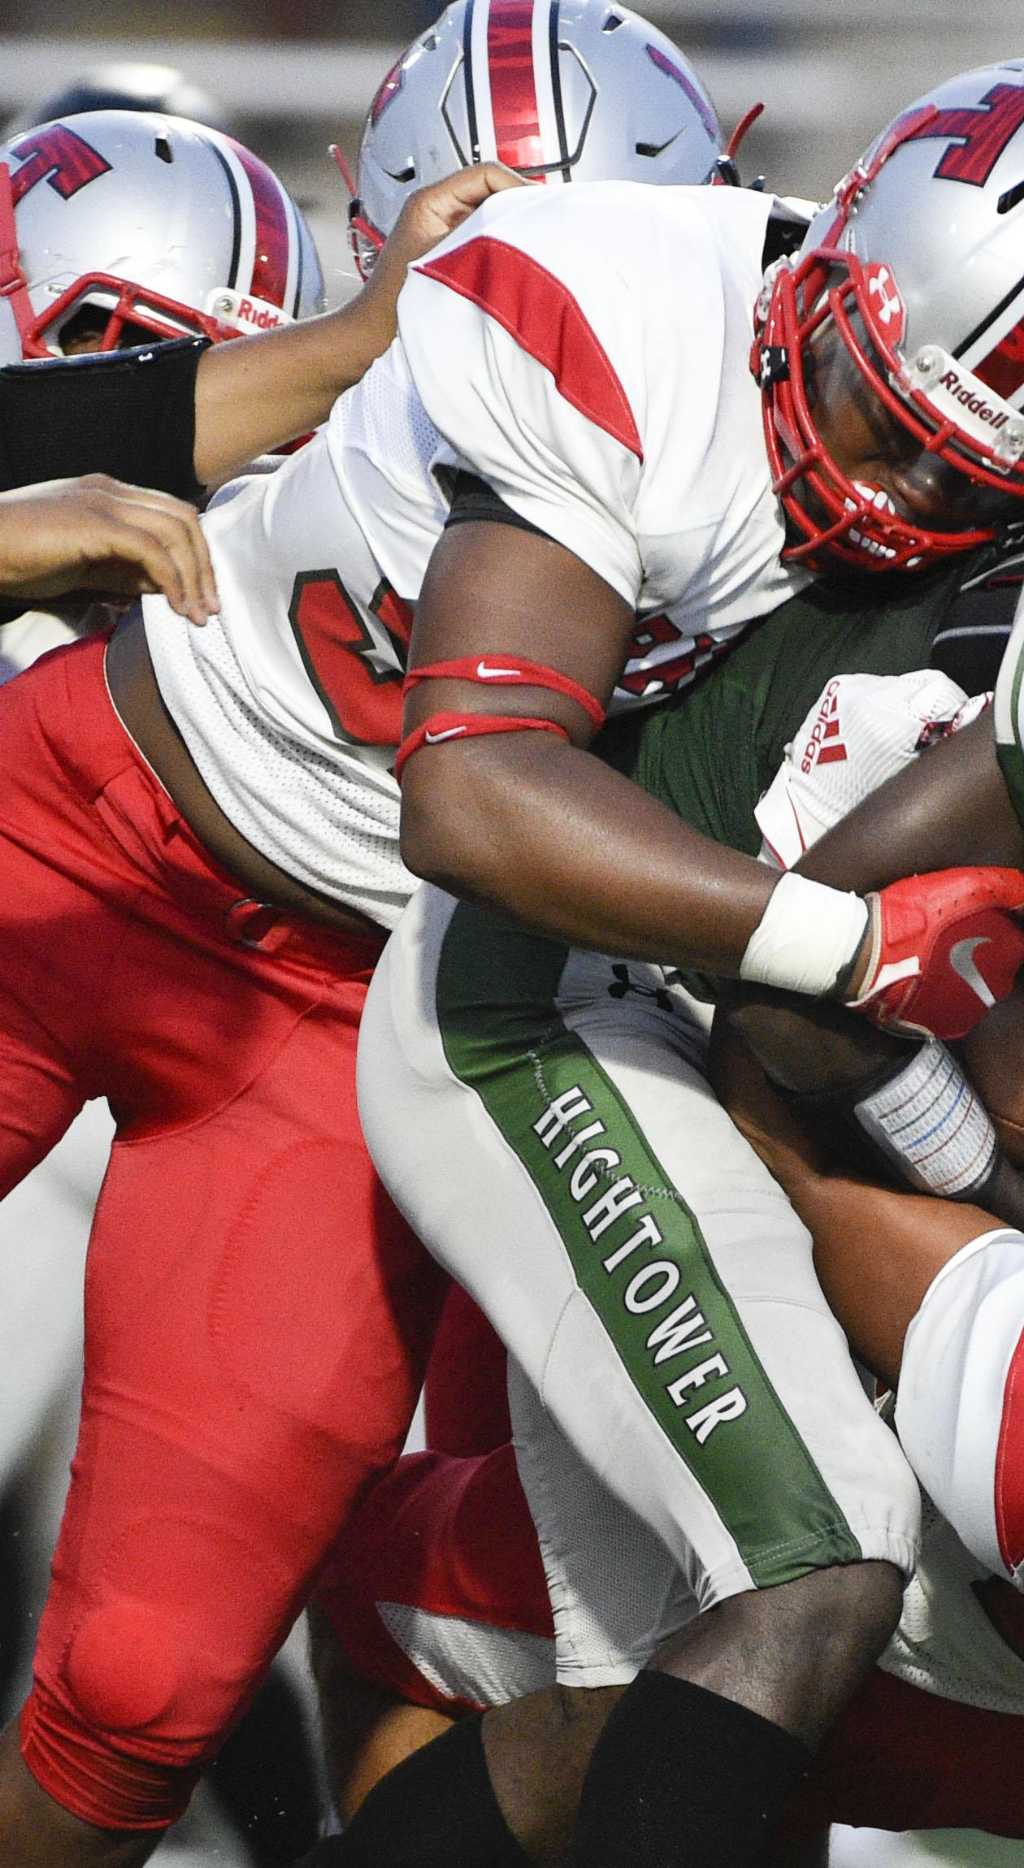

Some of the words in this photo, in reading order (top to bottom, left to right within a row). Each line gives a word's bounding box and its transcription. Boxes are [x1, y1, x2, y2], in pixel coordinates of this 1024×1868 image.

[238, 298, 284, 329] Ridd
[939, 370, 1010, 430] Riddell
[801, 680, 840, 774] adidas
[532, 1085, 748, 1445] HIGHTOWER
